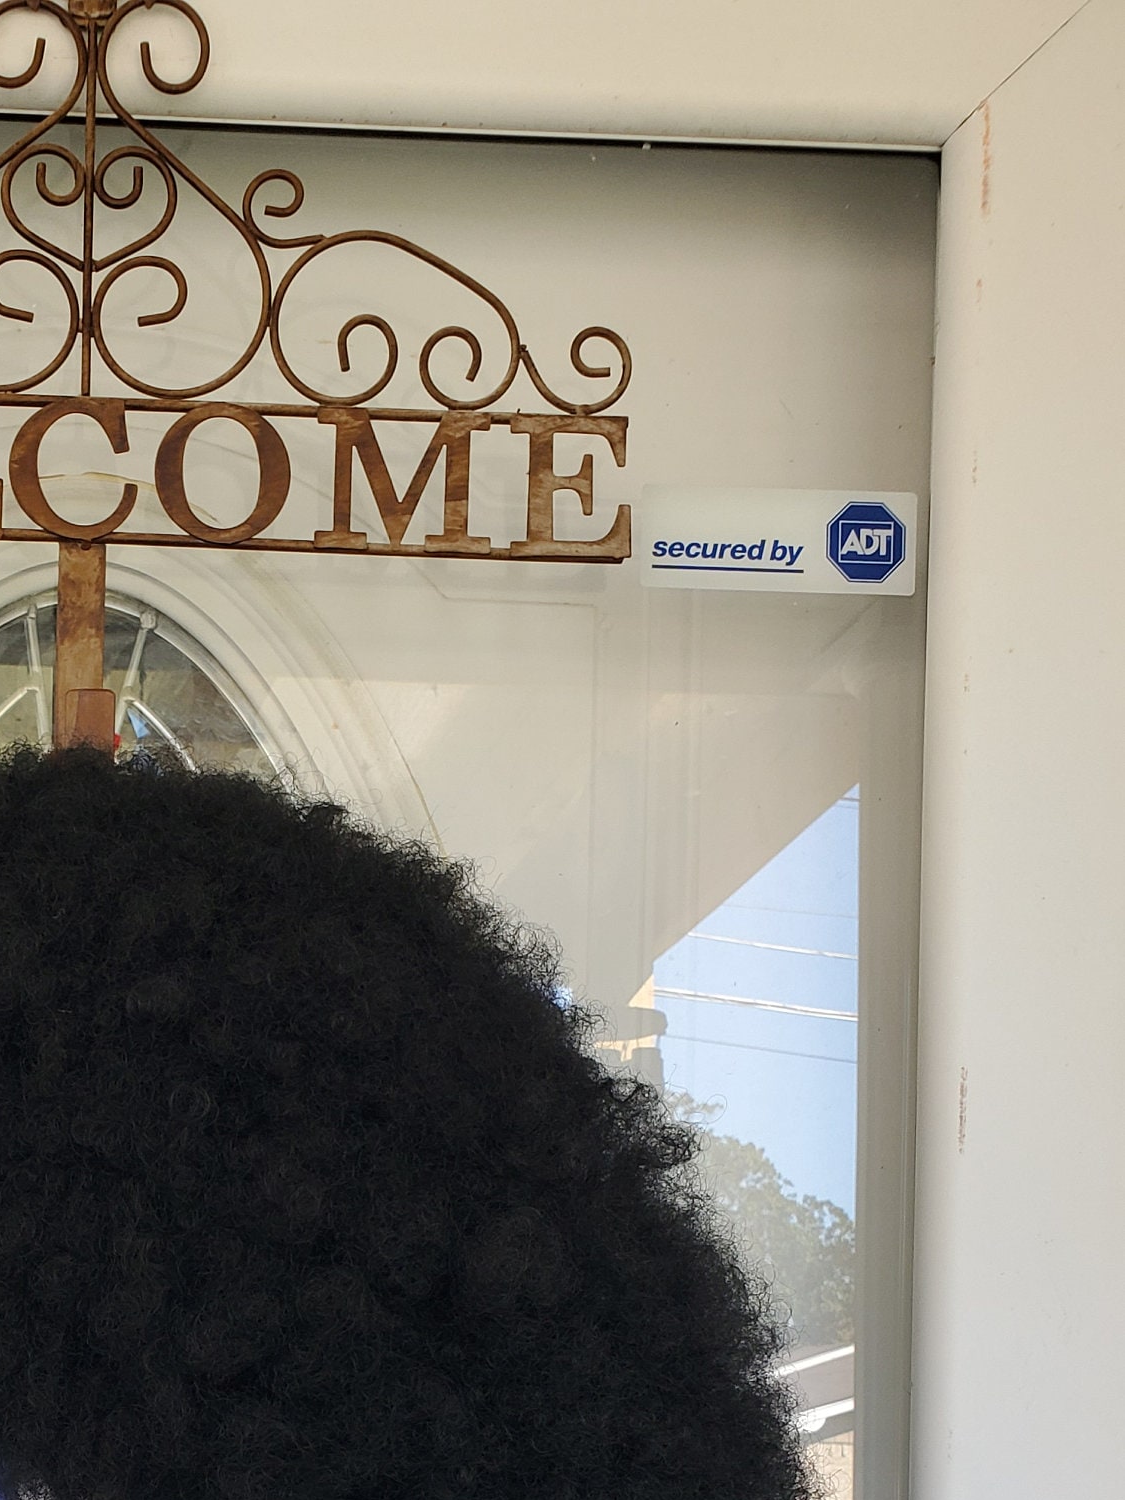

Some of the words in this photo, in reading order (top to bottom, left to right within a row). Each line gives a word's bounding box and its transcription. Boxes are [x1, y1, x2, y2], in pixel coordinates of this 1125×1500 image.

[652, 539, 766, 560] secured
[769, 540, 803, 565] by
[840, 528, 892, 556] ADT
